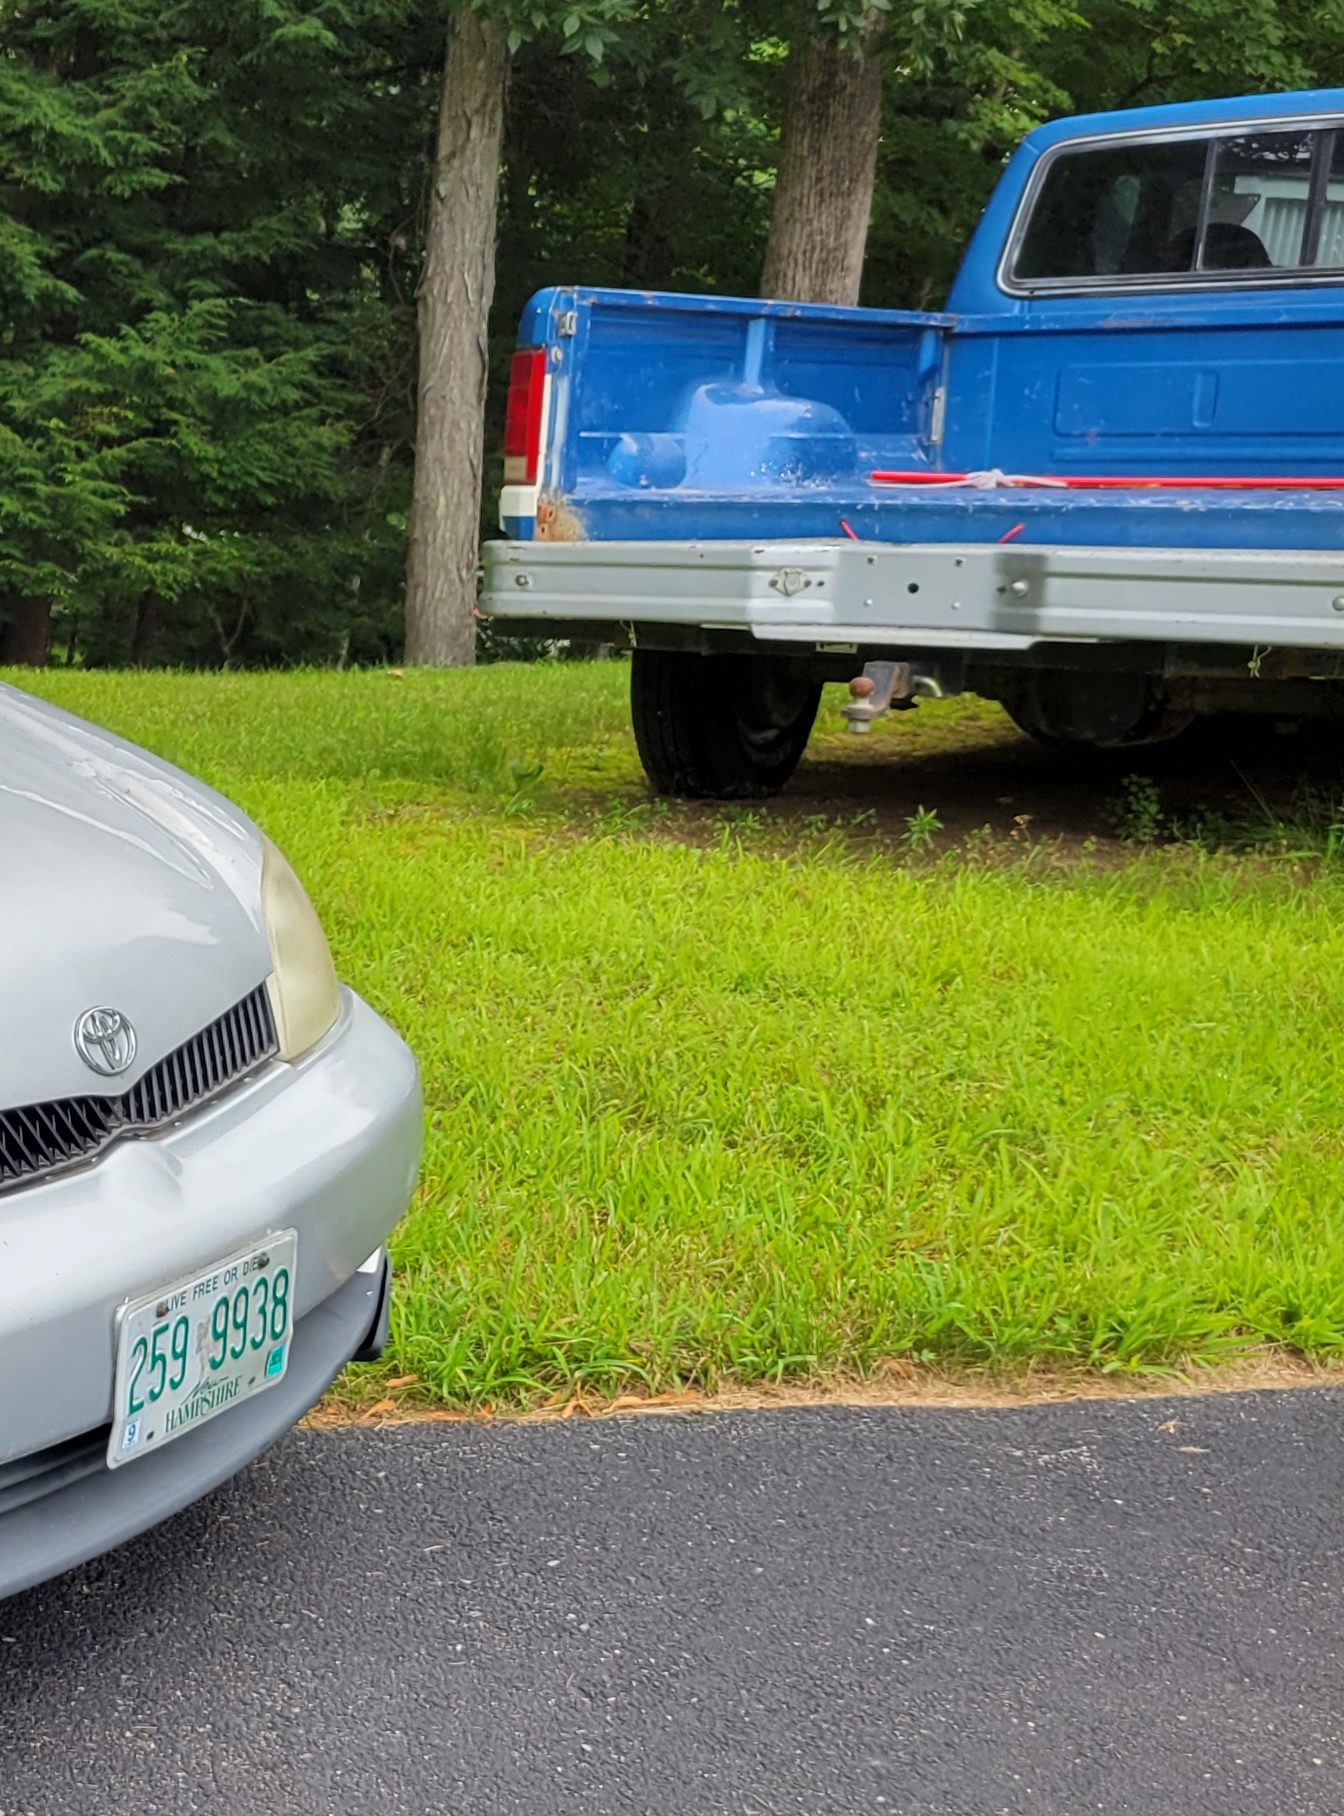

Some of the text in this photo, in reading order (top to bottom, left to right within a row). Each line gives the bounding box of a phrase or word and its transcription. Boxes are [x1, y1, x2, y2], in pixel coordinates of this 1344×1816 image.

[165, 1256, 259, 1313] LIVE FREE OR DIE
[129, 1268, 289, 1415] 259 9938
[165, 1374, 242, 1433] HAMPSHIRE
[127, 1424, 136, 1443] 9
